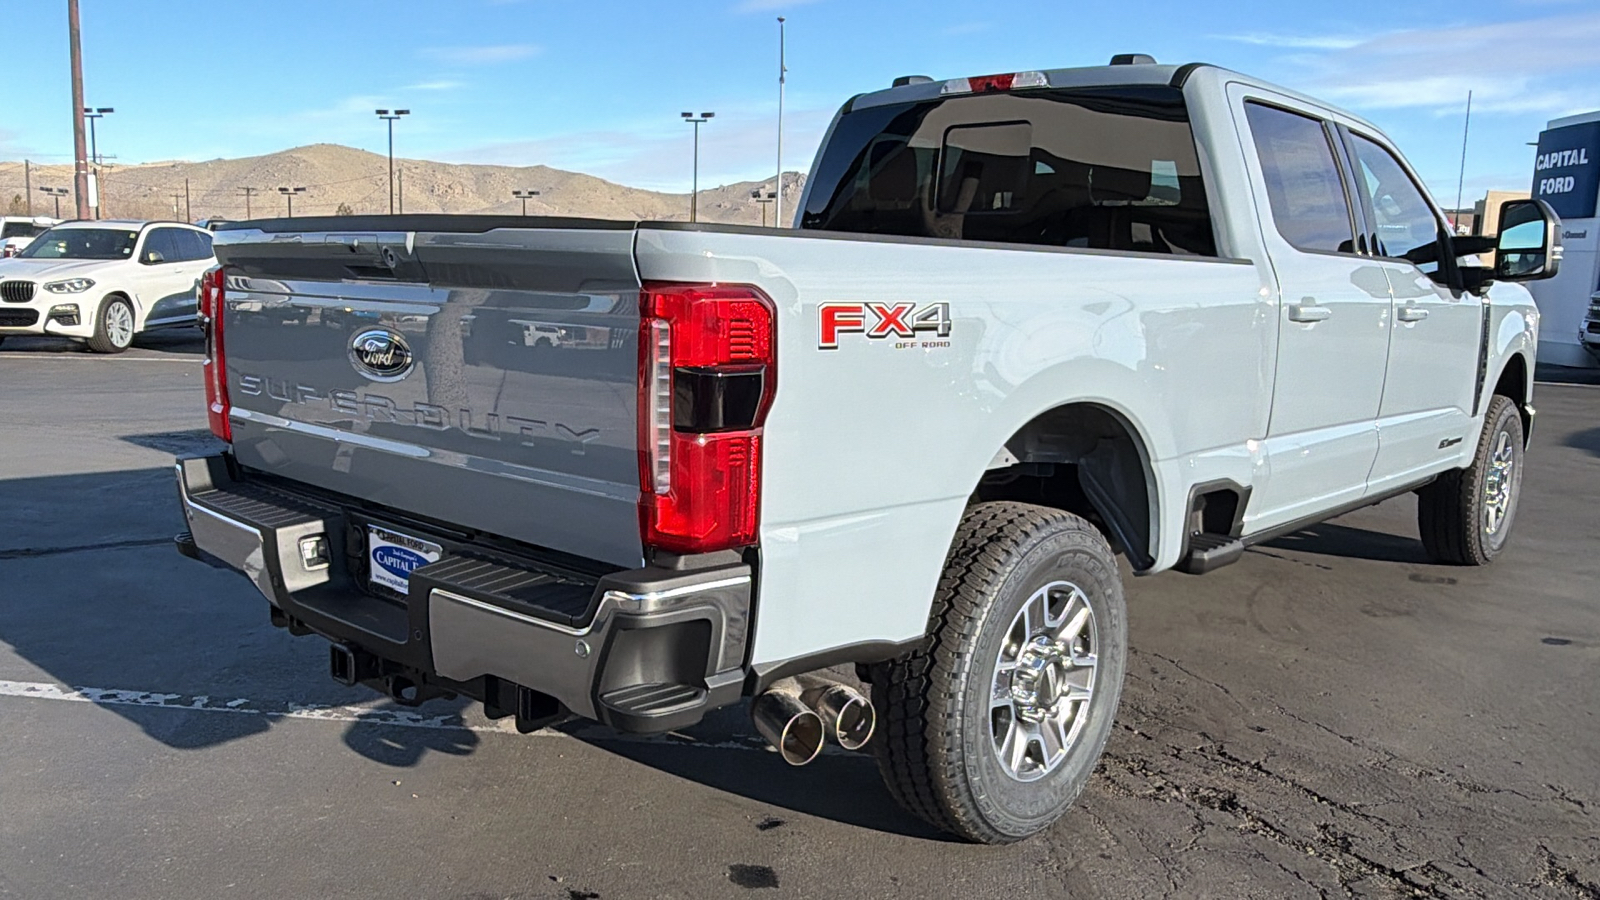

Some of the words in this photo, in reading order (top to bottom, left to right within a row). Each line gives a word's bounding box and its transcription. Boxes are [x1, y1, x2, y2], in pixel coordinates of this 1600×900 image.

[1536, 148, 1589, 171] CAPITAL
[1539, 176, 1575, 196] FORD
[817, 302, 952, 350] FX4
[362, 339, 395, 367] Ford
[239, 375, 397, 424] SUPER
[411, 399, 601, 455] DUTY
[376, 550, 411, 572] CAPITAL
